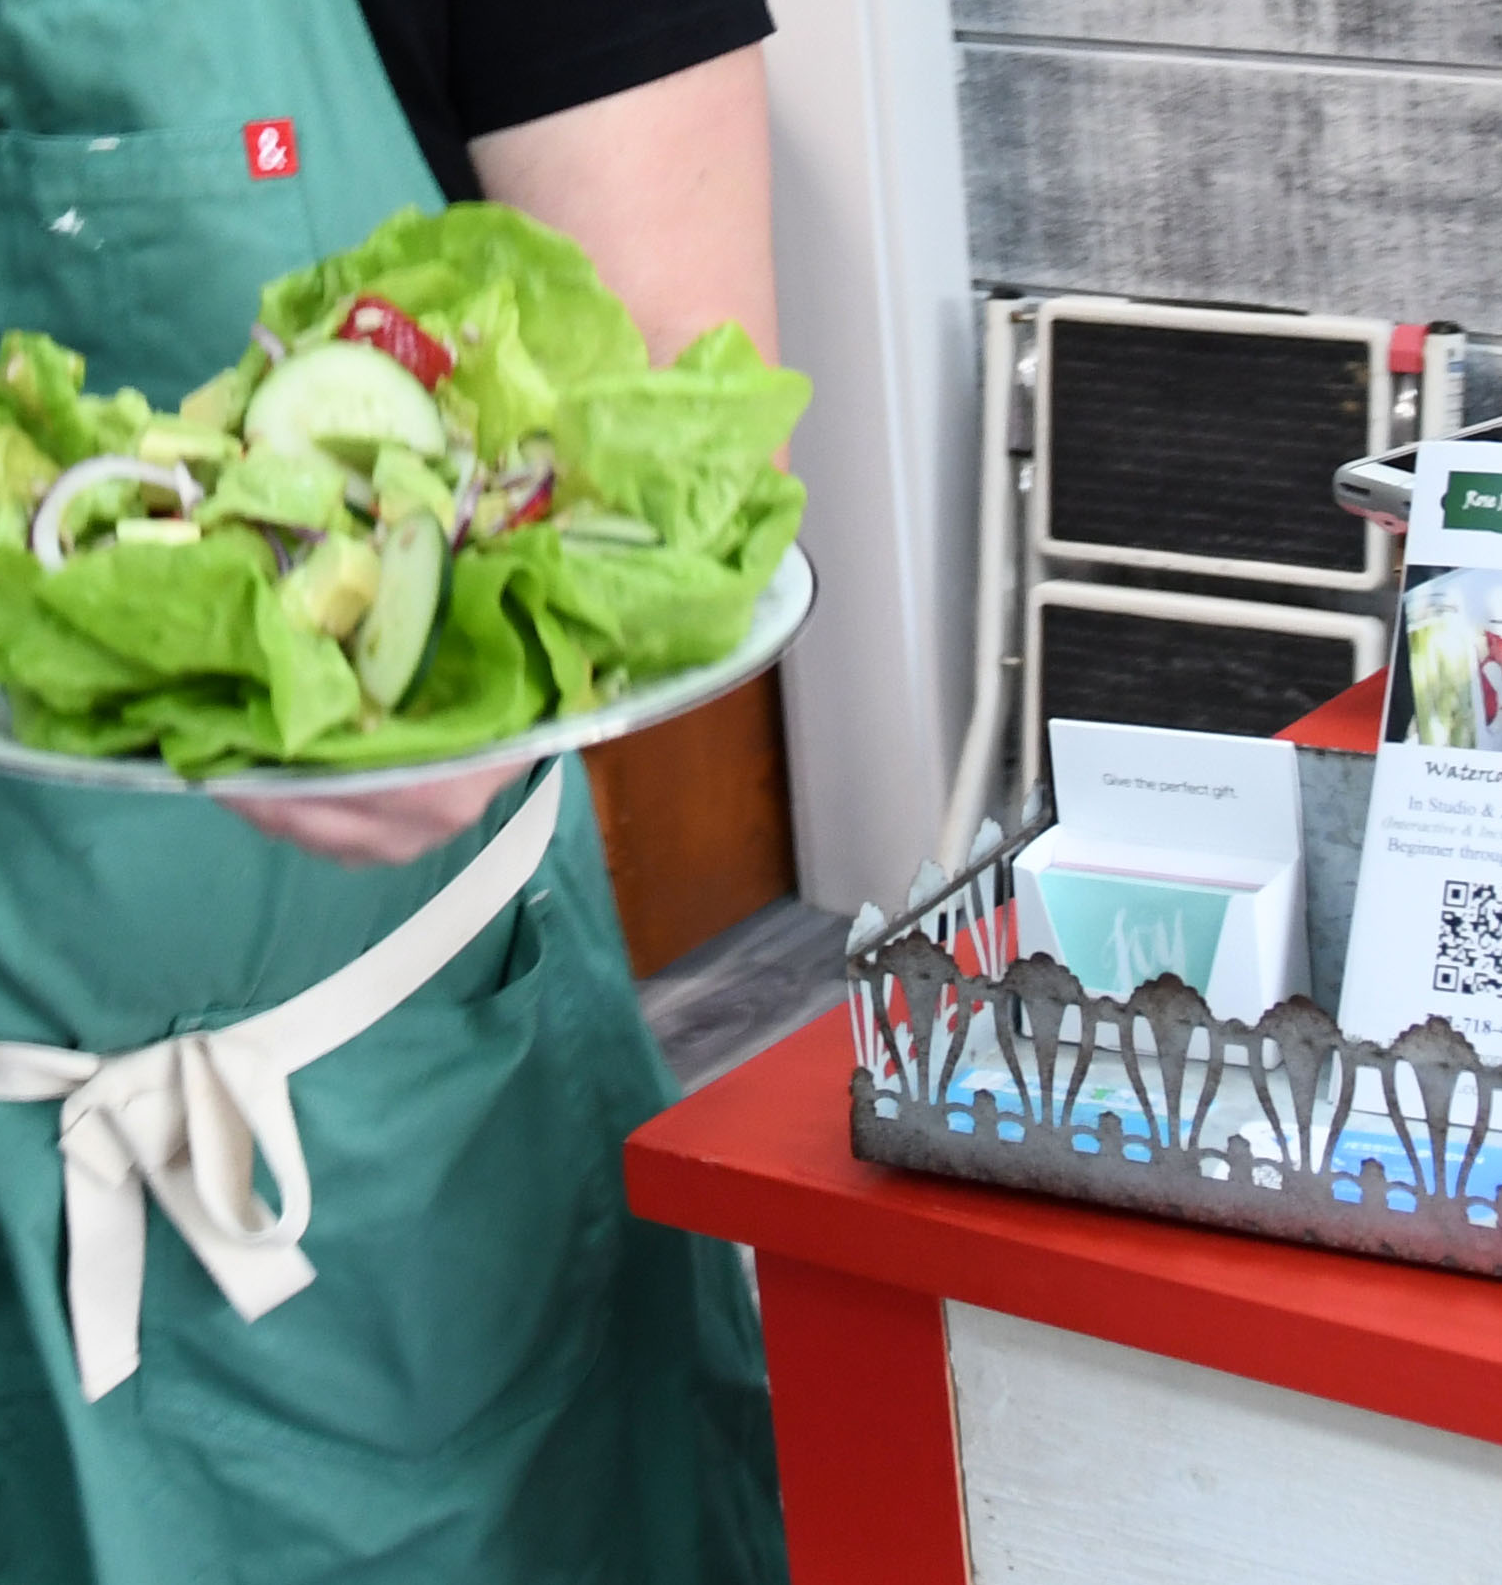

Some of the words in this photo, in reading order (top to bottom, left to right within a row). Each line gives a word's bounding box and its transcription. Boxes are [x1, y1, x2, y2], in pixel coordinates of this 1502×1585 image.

[1102, 772, 1132, 789] Give
[1134, 775, 1156, 791] the
[1159, 781, 1209, 798] perfect
[1408, 794, 1423, 811] In
[1428, 797, 1476, 817] Studio
[1481, 801, 1495, 818] &
[1387, 836, 1456, 858] Beginner
